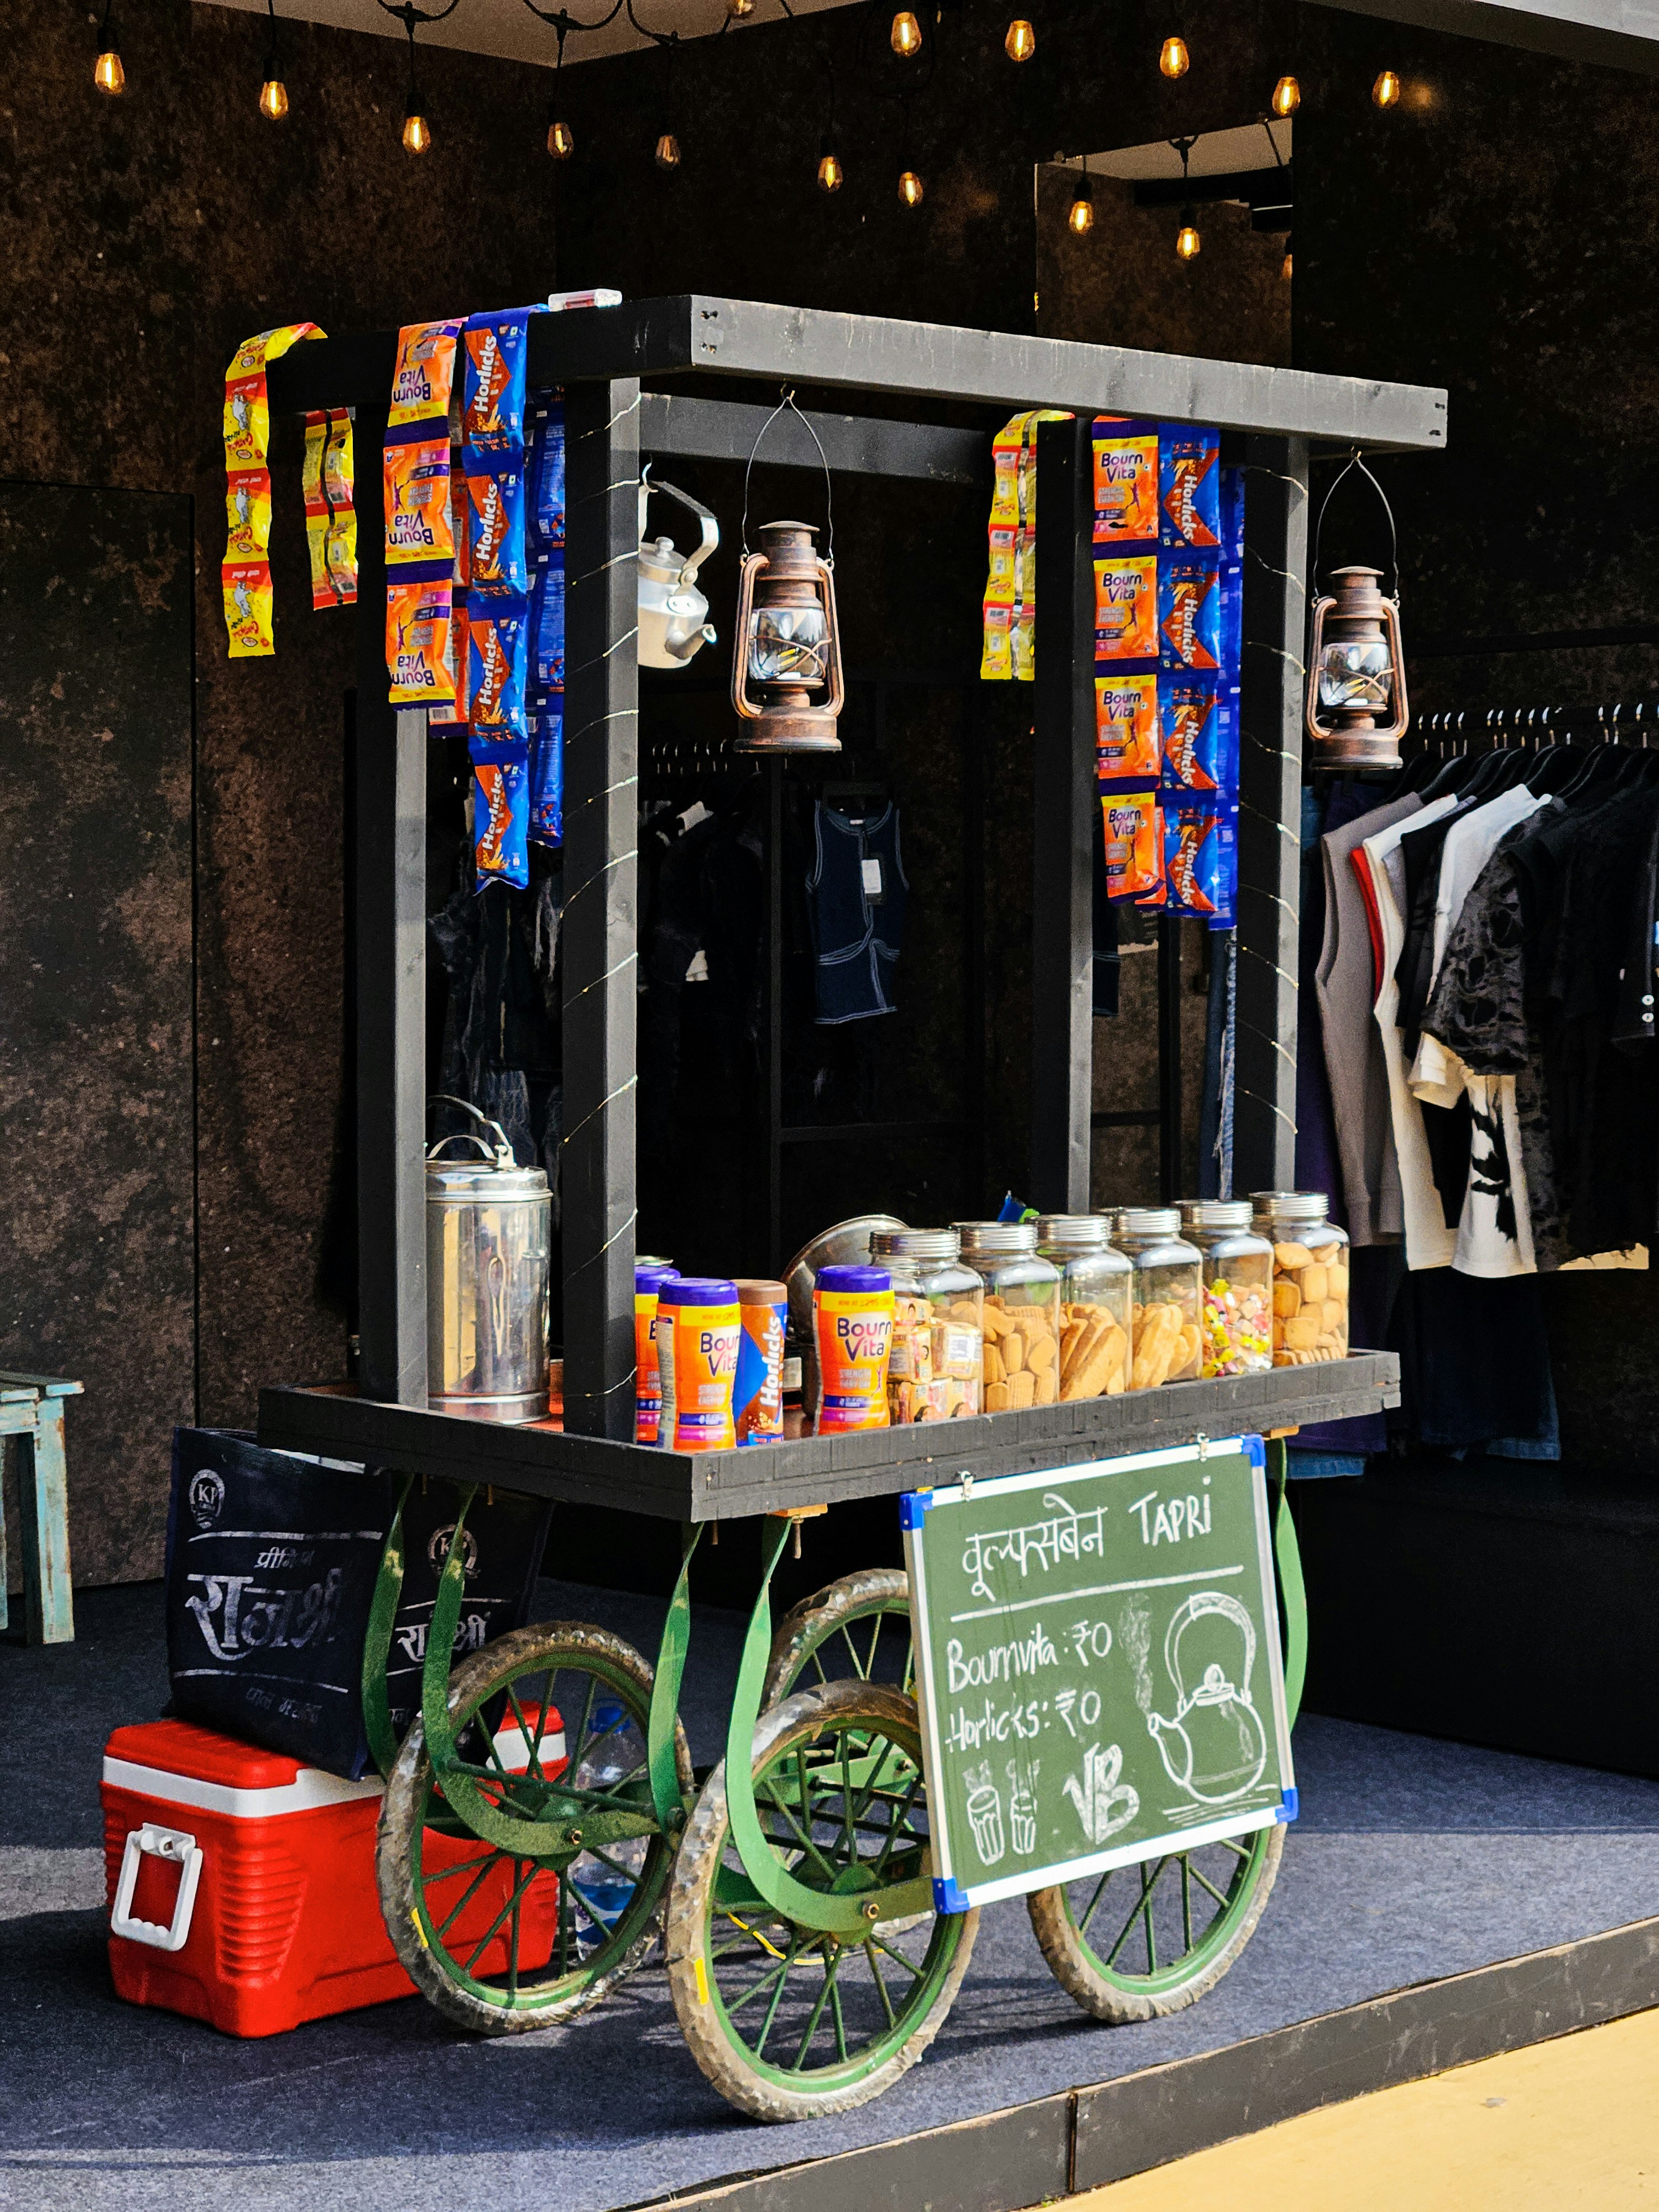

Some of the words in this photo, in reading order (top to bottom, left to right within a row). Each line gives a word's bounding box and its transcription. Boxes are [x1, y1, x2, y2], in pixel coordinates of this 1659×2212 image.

[400, 364, 426, 386] Vita
[474, 335, 497, 412] Horlicks
[393, 382, 431, 403] Bourn
[1102, 452, 1143, 467] Bourn
[1107, 465, 1136, 483] Vita
[1181, 475, 1198, 540] Horlicks
[395, 509, 425, 531] Vita
[476, 483, 497, 560] Horlicks
[388, 528, 434, 545] Bourn
[1103, 573, 1142, 587] Bourn
[1108, 585, 1135, 603] Vita
[1182, 598, 1199, 664] Horlicks
[398, 651, 425, 672] Vita
[479, 628, 497, 705] Horlicks
[392, 670, 435, 687] Bourn
[1103, 691, 1141, 705] Bourn
[1108, 702, 1135, 722] Vita
[482, 773, 502, 849] Horlicks
[1109, 808, 1141, 823] Bourn
[1113, 820, 1135, 839] Vita
[837, 1317, 891, 1337] Bourn
[701, 1332, 740, 1353] Bour
[845, 1337, 884, 1361] Vita
[759, 1317, 781, 1406] Horlicks
